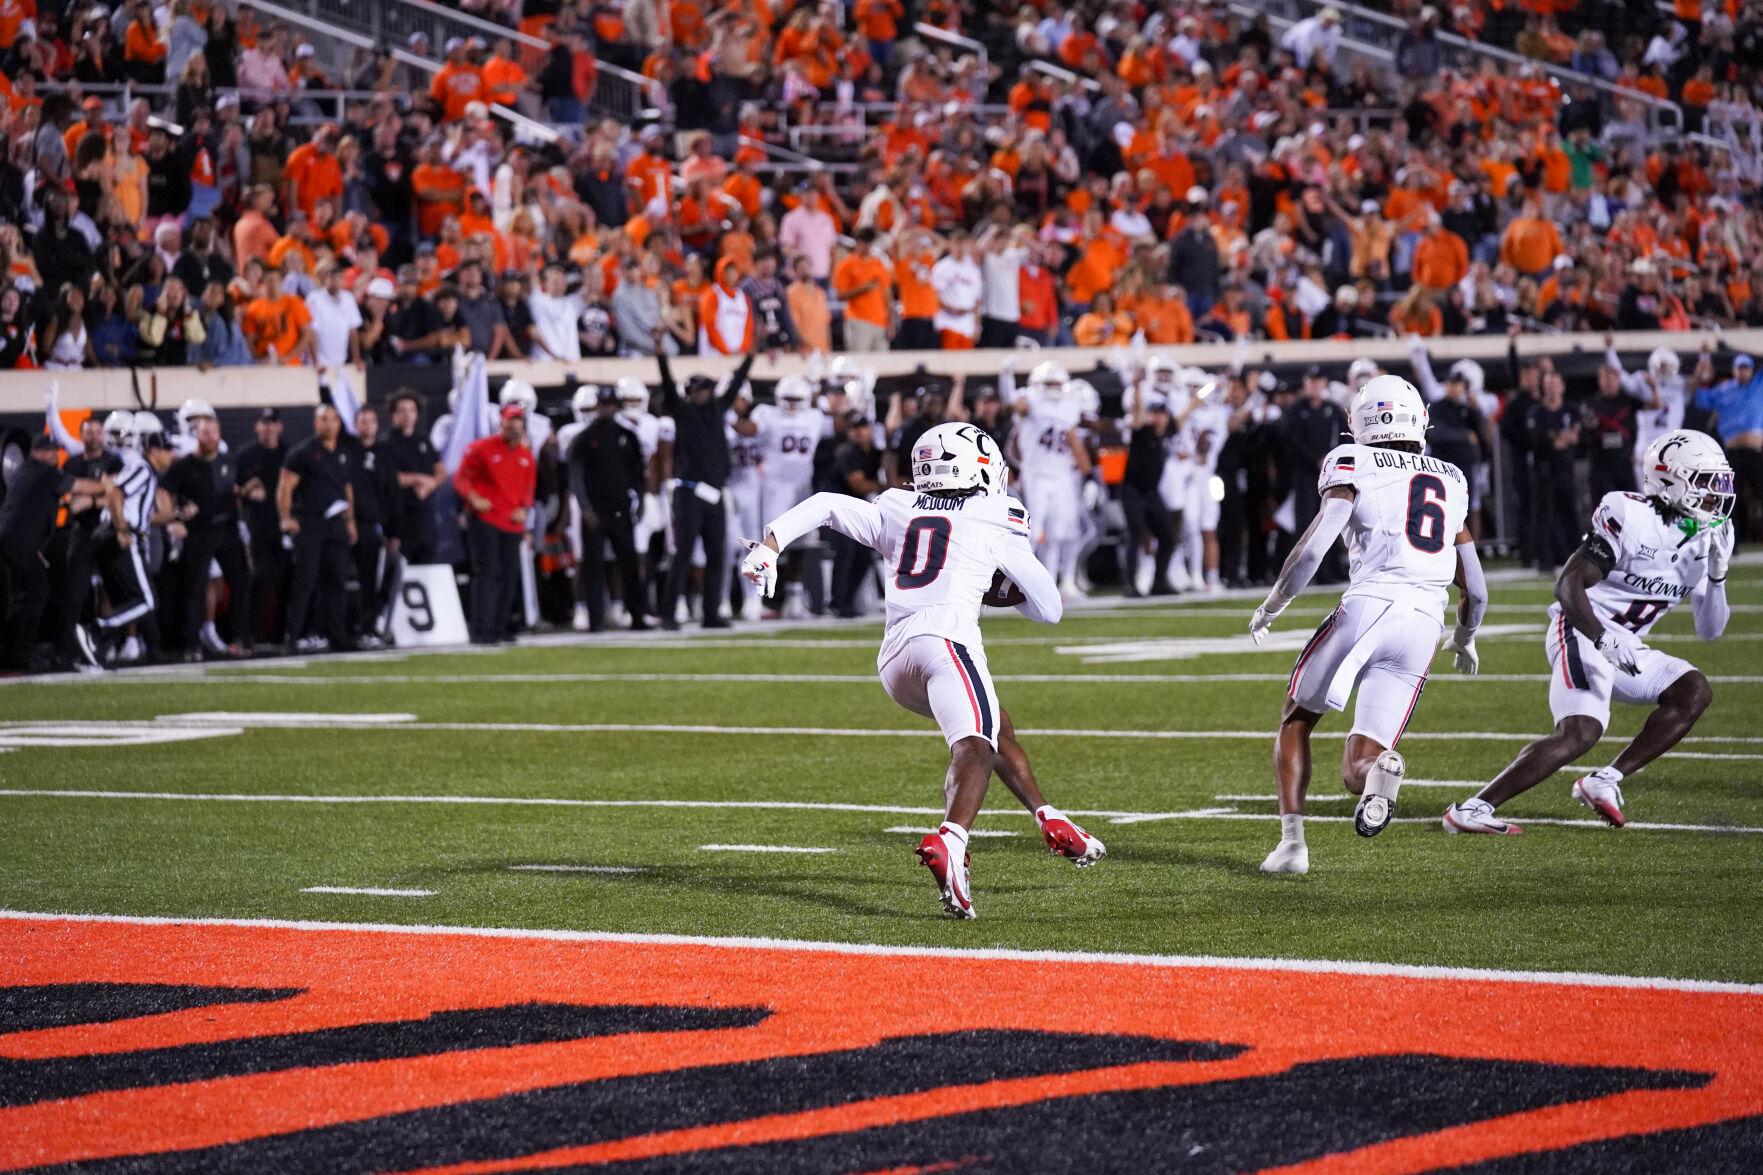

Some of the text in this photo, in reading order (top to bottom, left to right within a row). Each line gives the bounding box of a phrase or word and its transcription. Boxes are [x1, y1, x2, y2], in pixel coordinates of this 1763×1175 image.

[911, 494, 967, 511] MCDOOM
[1405, 473, 1447, 554] 6
[895, 515, 952, 590] 0
[402, 581, 435, 632] 9
[1624, 573, 1695, 598] CINCINNAT
